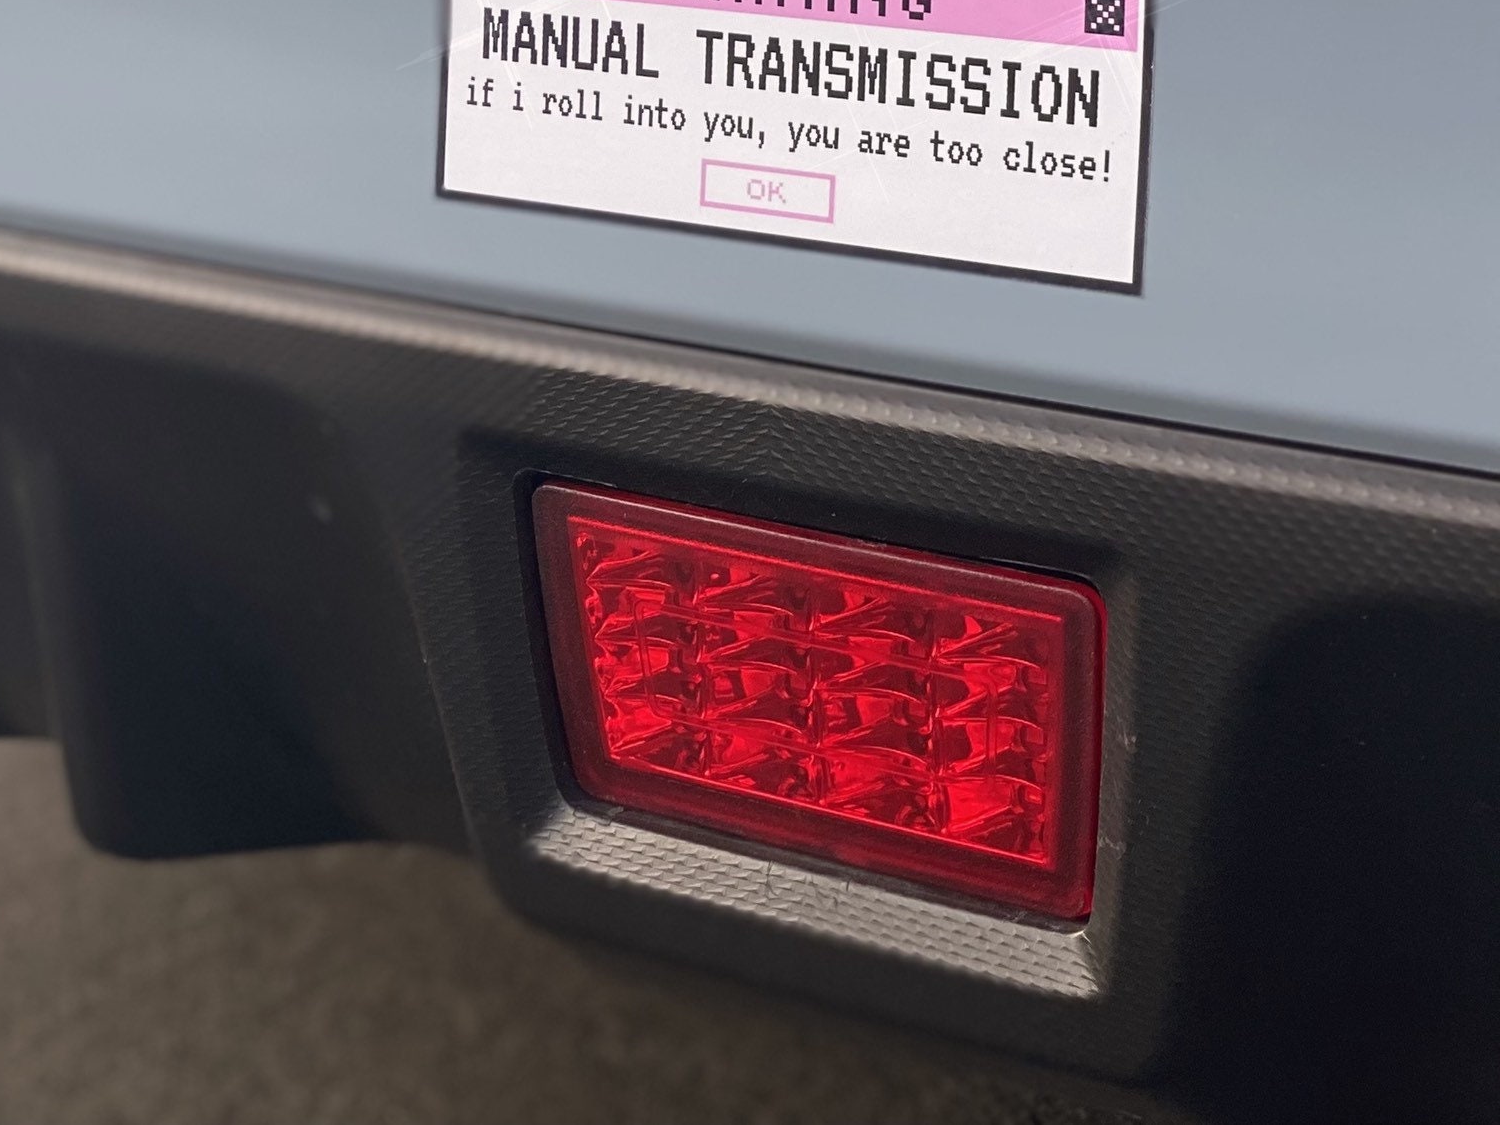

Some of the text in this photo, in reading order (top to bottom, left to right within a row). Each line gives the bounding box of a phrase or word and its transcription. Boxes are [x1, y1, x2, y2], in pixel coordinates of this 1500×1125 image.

[482, 7, 1099, 128] MANUAL TRANSMISSION
[466, 77, 1113, 182] if i roll into you, you are too close!
[746, 178, 787, 204] OK
